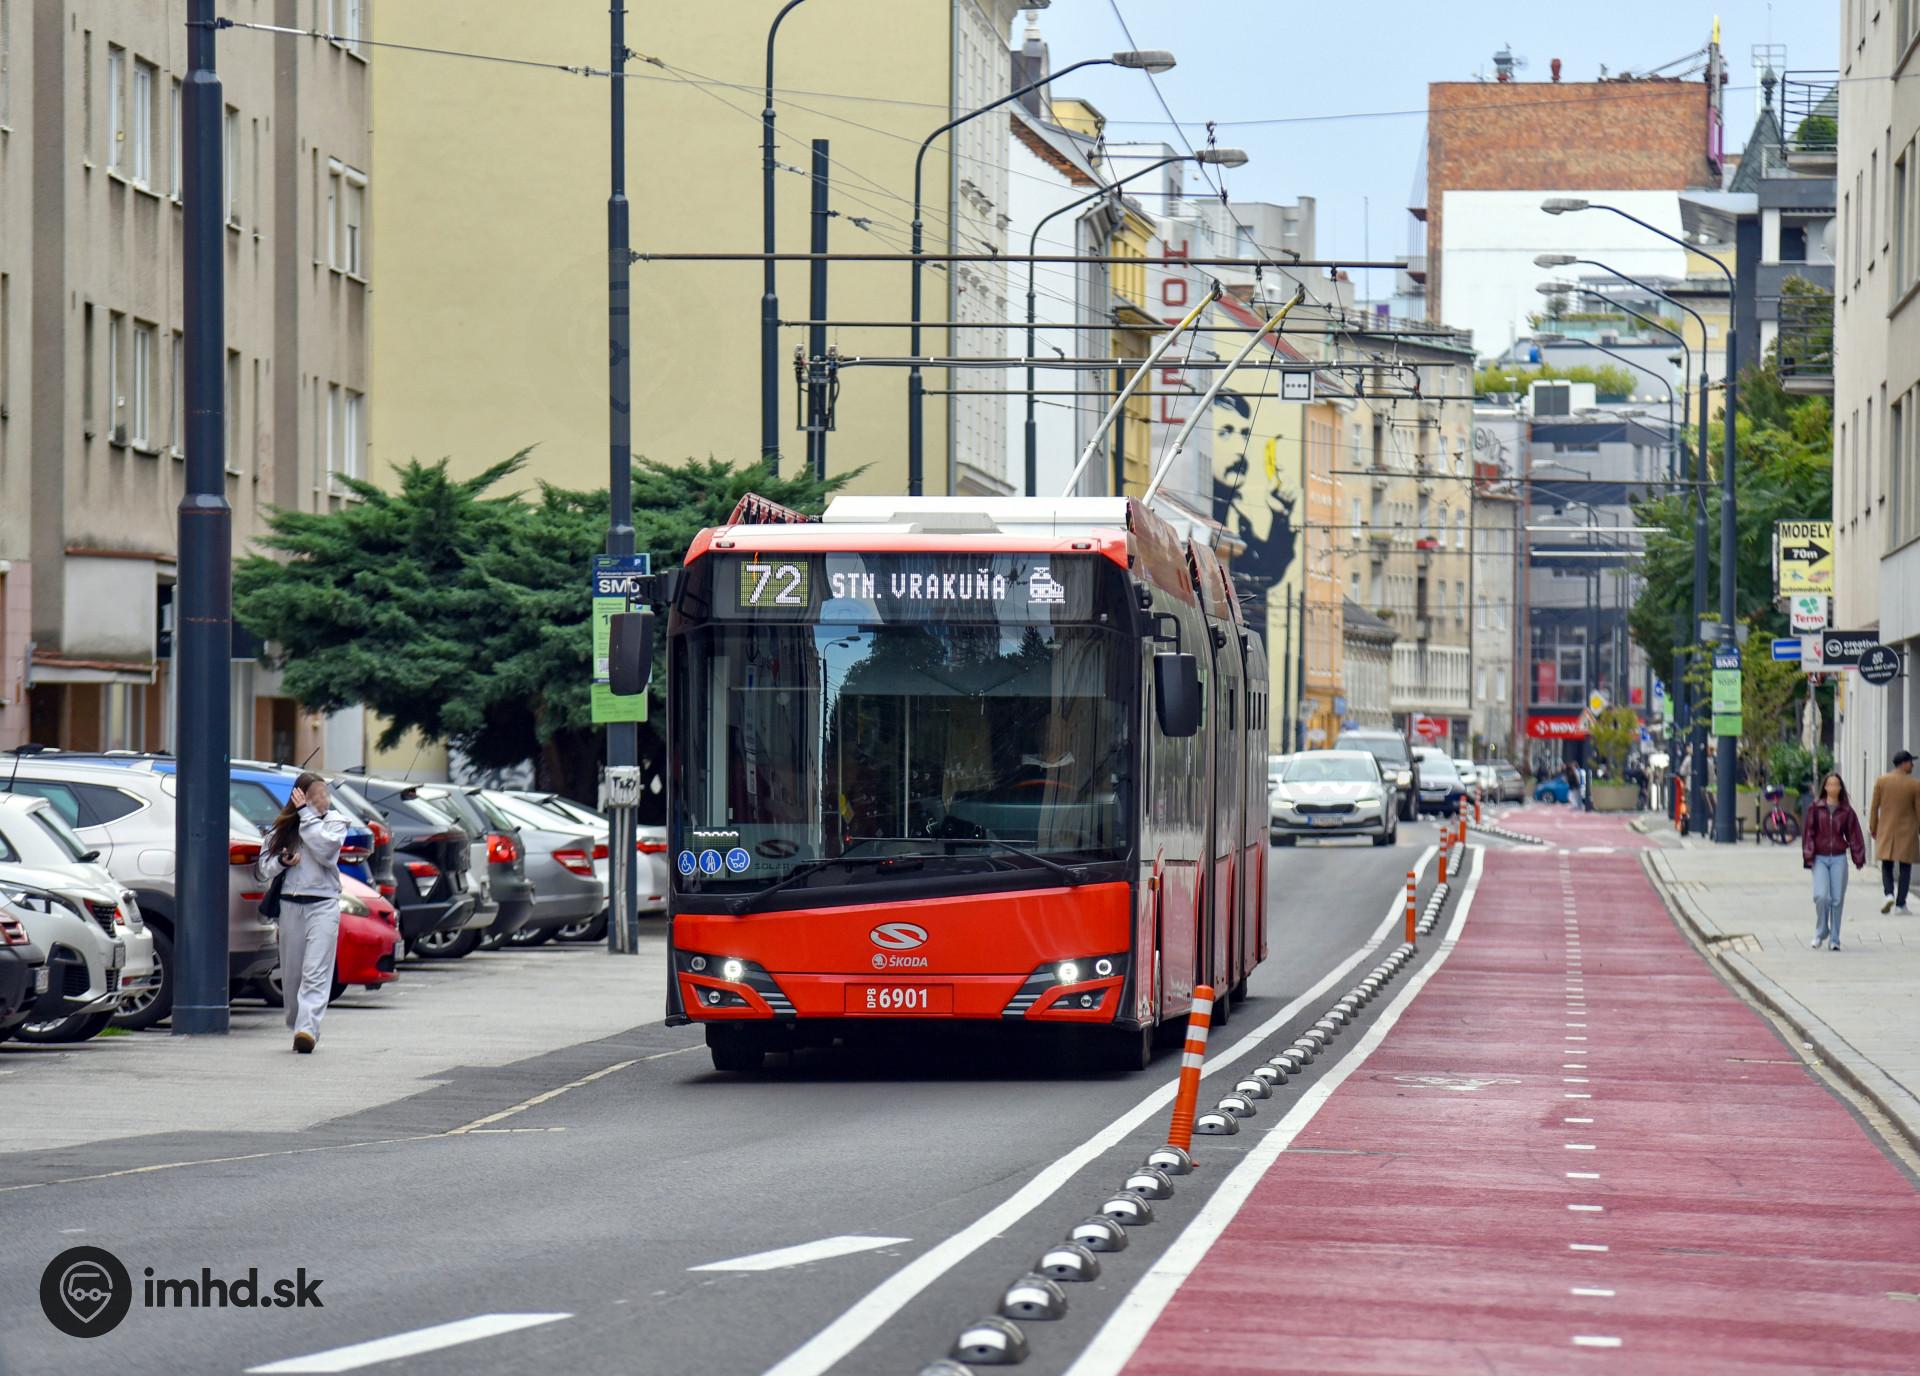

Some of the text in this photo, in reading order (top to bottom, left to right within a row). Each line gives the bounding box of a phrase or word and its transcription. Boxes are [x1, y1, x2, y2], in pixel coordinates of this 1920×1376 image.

[1782, 524, 1832, 538] MODELY
[1792, 549, 1818, 559] 70m
[746, 564, 1006, 605] 72 STN. VRAKUŇA
[1795, 614, 1824, 623] Terno
[889, 955, 928, 967] ŠKODA
[866, 988, 928, 1008] DPB 6901
